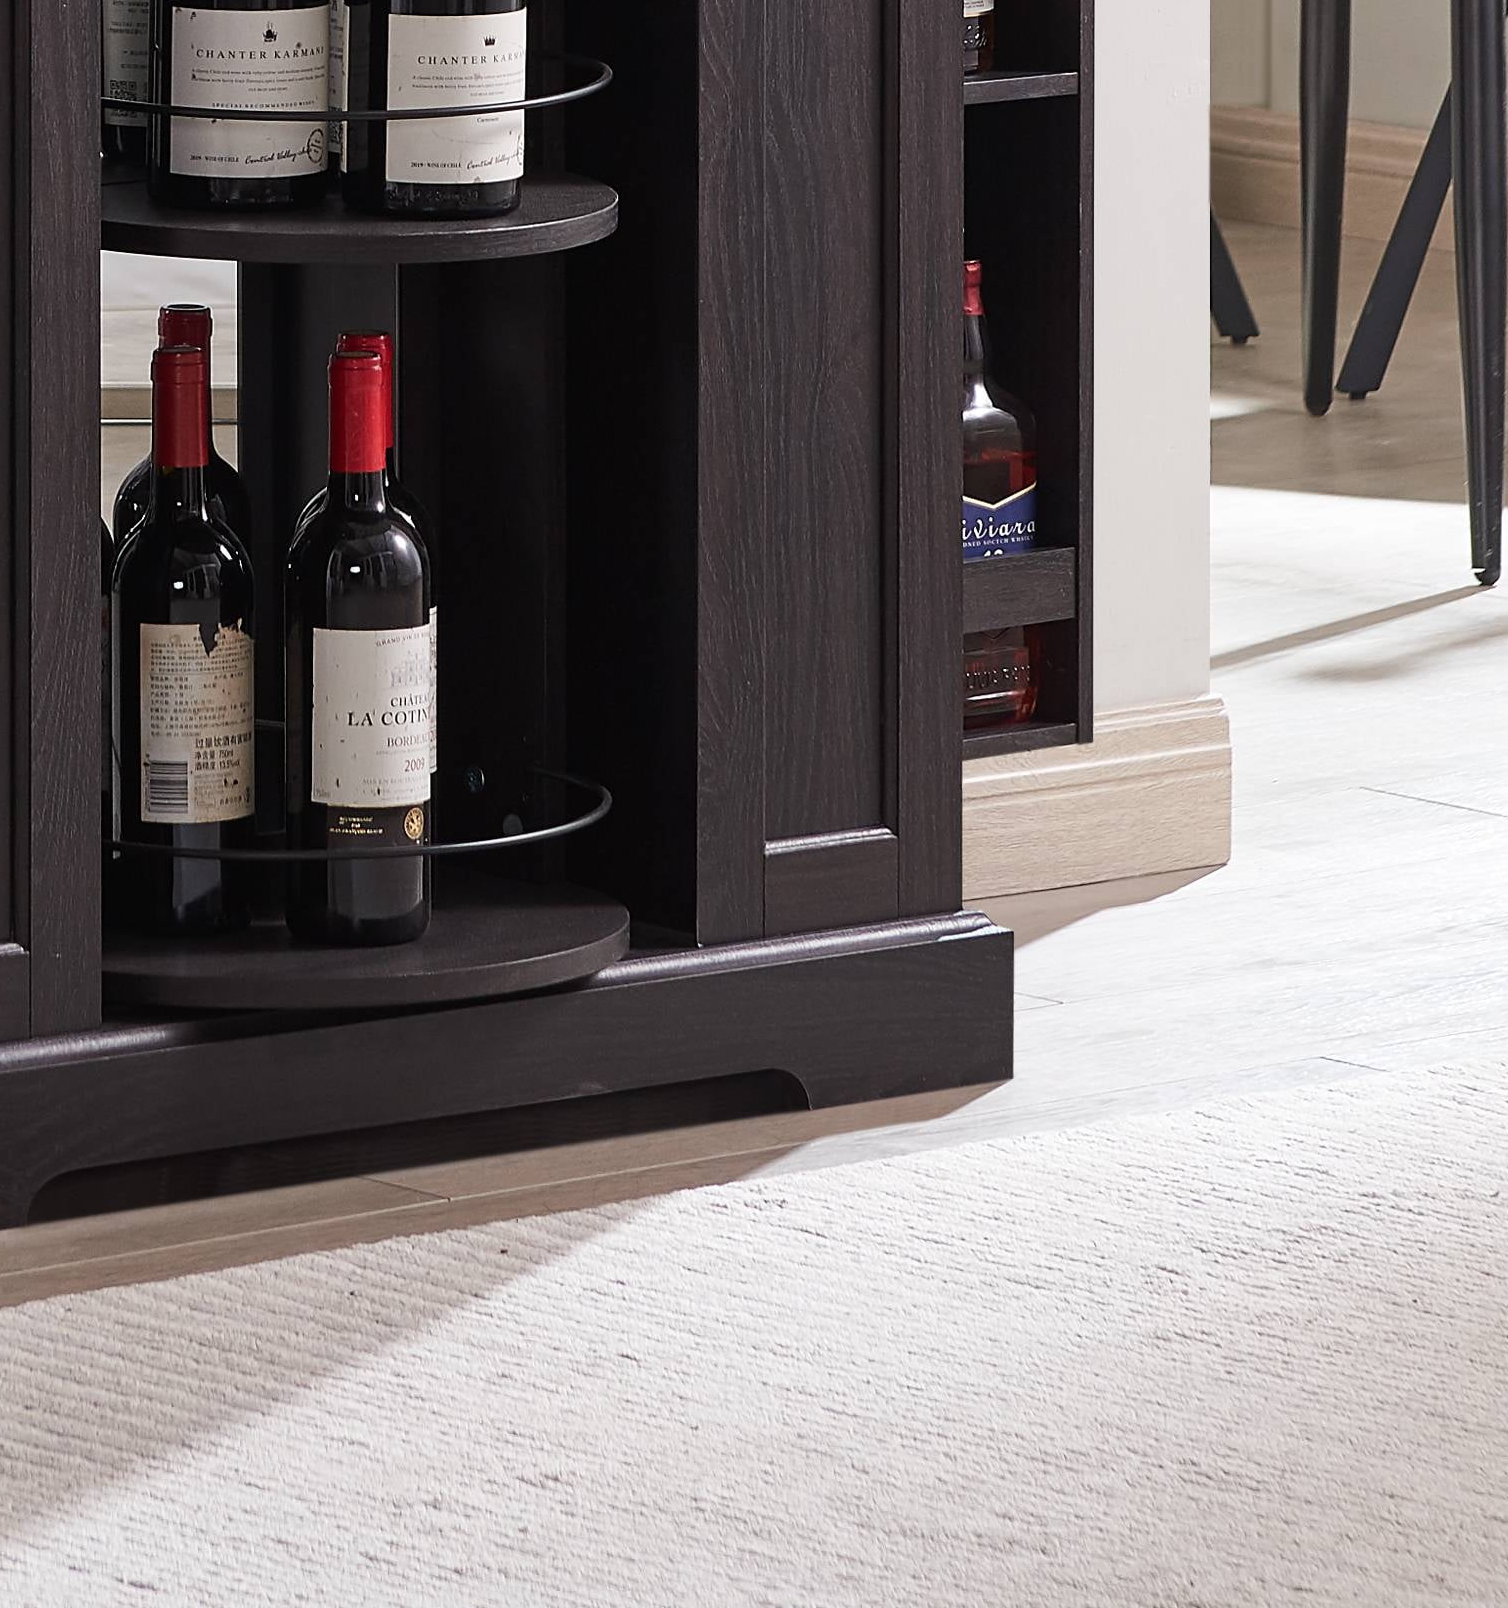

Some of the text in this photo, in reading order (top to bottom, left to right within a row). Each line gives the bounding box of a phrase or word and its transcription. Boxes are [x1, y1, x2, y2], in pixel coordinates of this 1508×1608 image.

[196, 49, 267, 60] CHANTER
[417, 55, 487, 65] CHANTER
[962, 516, 1035, 540] iviara
[390, 693, 429, 708] CHÂTEA
